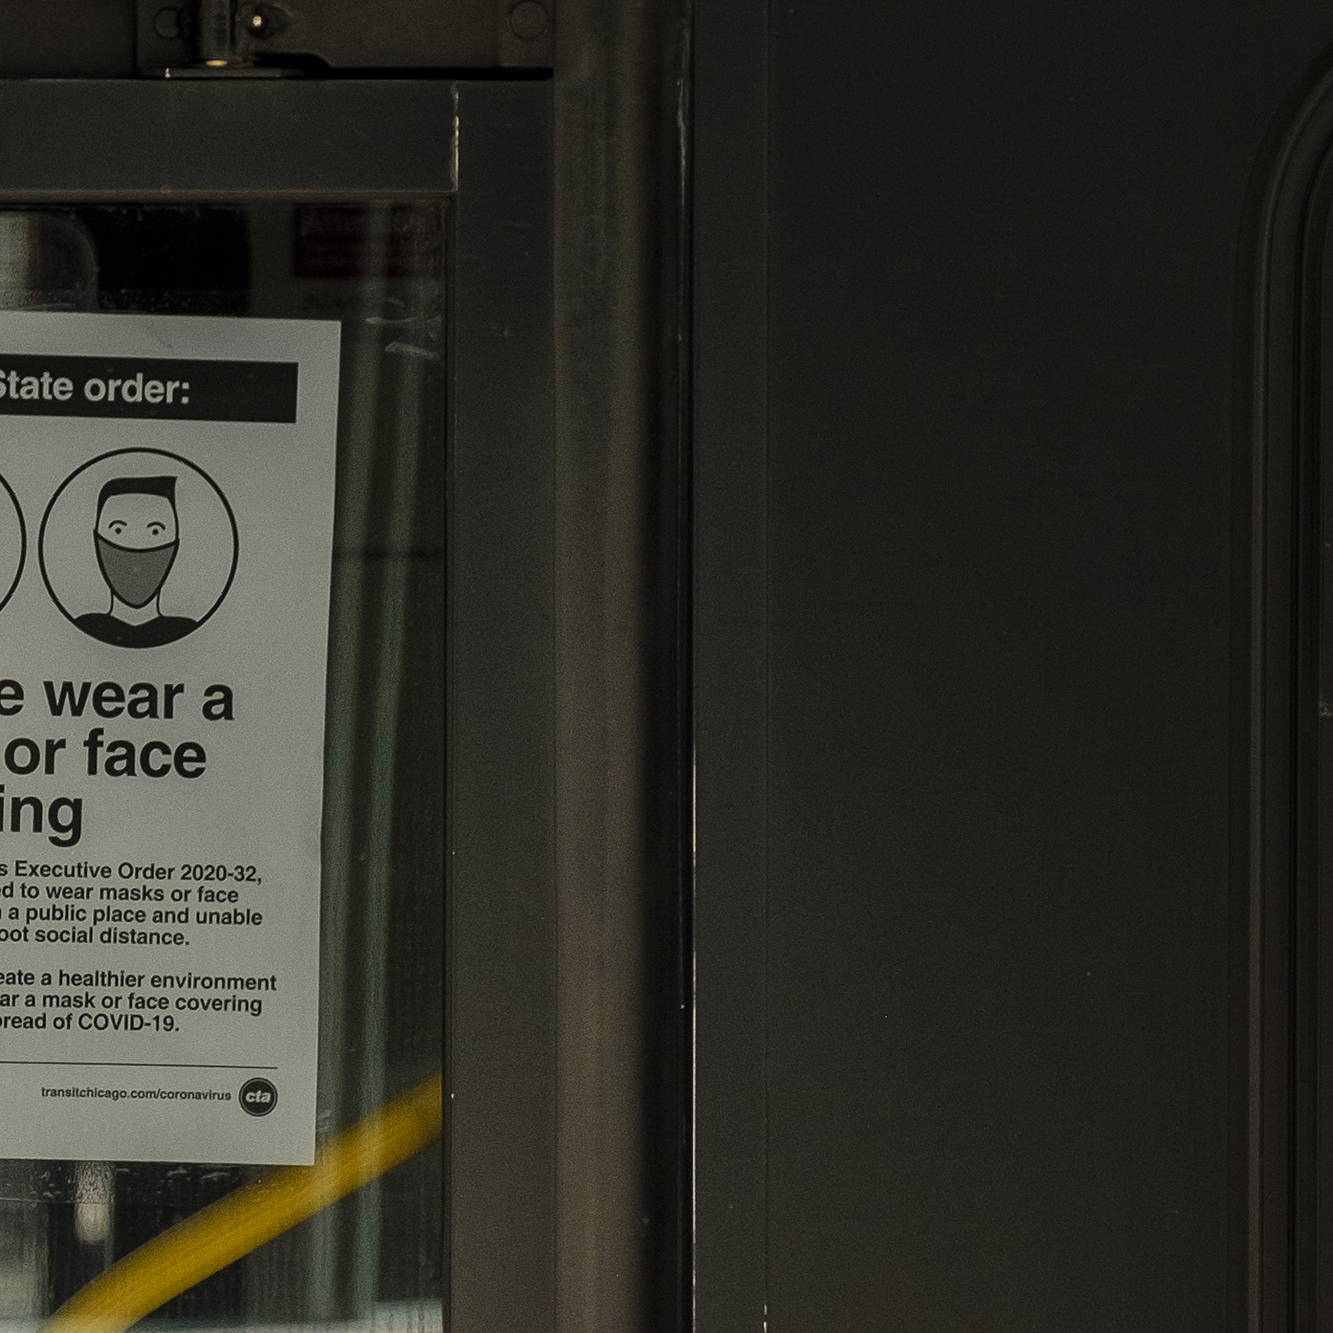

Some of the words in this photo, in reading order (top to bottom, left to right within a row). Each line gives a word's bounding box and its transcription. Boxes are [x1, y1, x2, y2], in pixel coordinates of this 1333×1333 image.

[84, 373, 189, 404] order:
[44, 681, 184, 719] wear
[203, 685, 234, 721] a
[5, 738, 66, 775] or
[84, 728, 206, 778] face
[15, 860, 111, 878] Executive
[118, 862, 175, 880] Order
[181, 864, 261, 884] 2020-32,
[20, 883, 39, 898] to
[46, 887, 93, 899] wear
[100, 885, 164, 901] masks
[171, 889, 191, 902] or
[198, 886, 238, 903] face
[9, 907, 19, 920] a
[26, 904, 86, 924] public
[93, 906, 146, 925] place
[152, 908, 189, 923] and
[196, 908, 262, 925] unable
[35, 926, 93, 943] social
[100, 927, 189, 945] distance.
[41, 973, 51, 985] a
[59, 970, 145, 987] healthier
[151, 972, 276, 991] environment
[25, 994, 35, 1007] a
[43, 992, 95, 1008] mask
[102, 996, 122, 1008] or
[128, 993, 169, 1009] face
[176, 995, 262, 1016] covering
[53, 1013, 72, 1029] of
[79, 1013, 179, 1031] COVID-19.
[42, 1087, 231, 1101] transitchicago.com/coronavirus
[245, 1089, 272, 1103] cta
